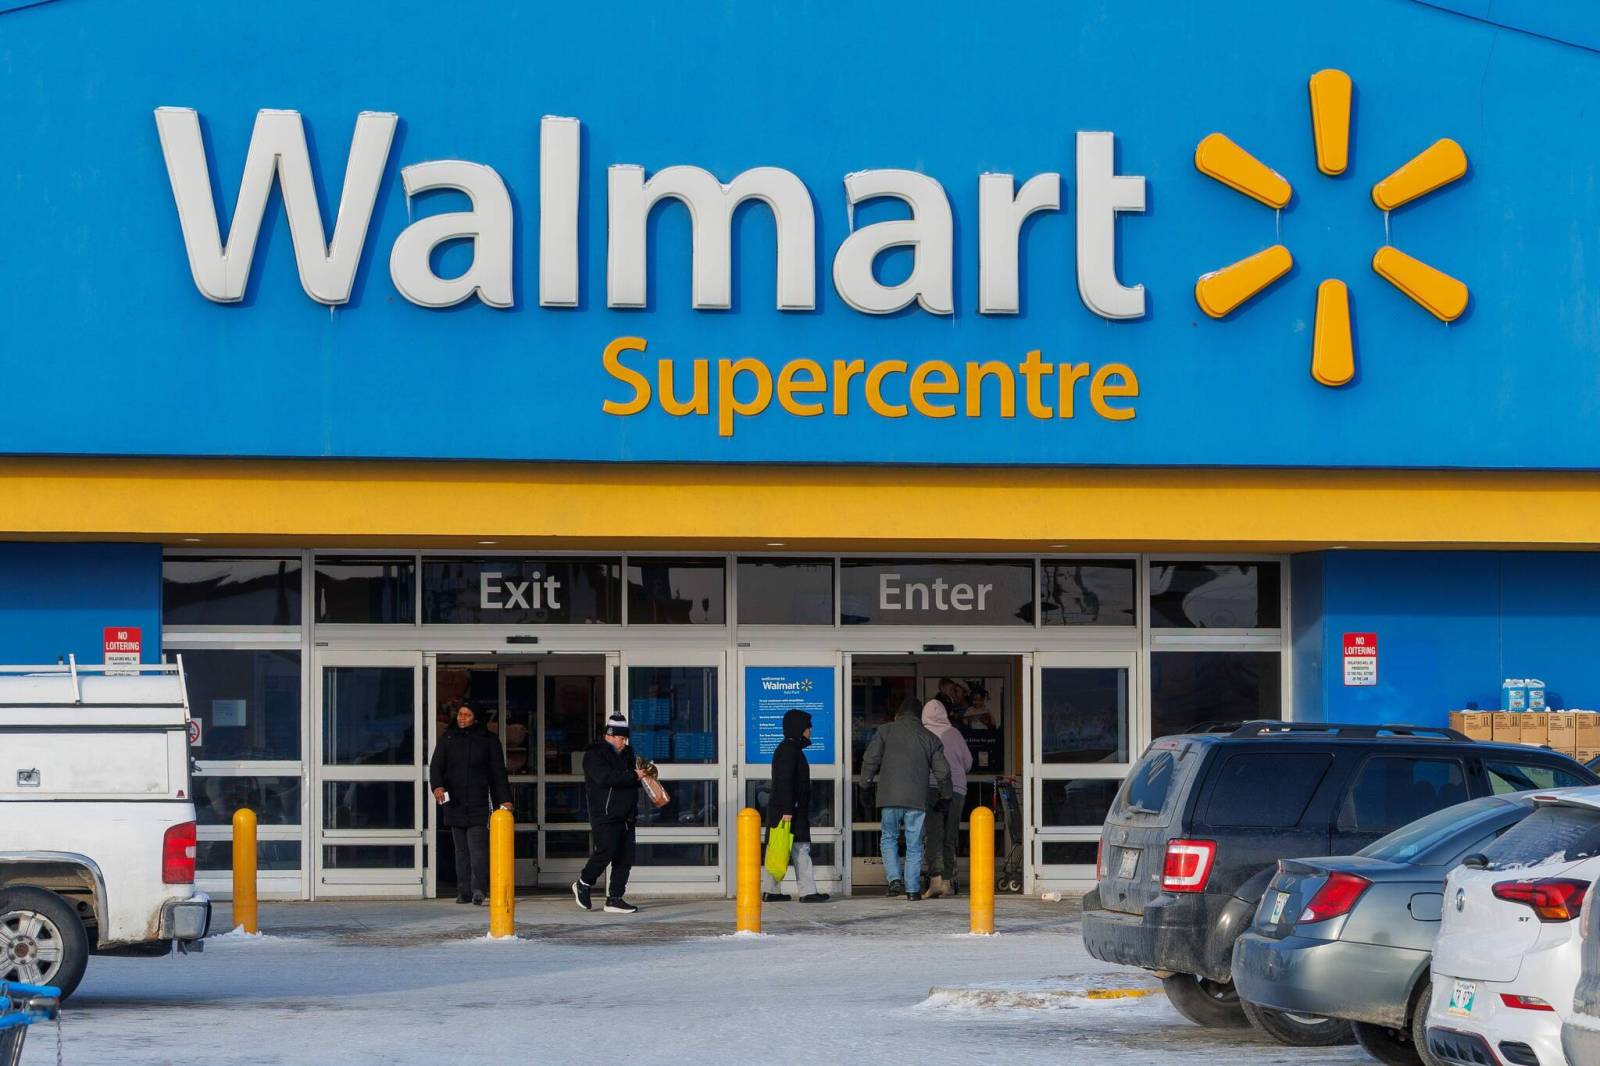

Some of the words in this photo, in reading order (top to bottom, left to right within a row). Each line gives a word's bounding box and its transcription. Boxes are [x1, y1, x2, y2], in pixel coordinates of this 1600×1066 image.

[154, 106, 1148, 321] Walmart
[602, 336, 1139, 438] Supercentre
[479, 572, 562, 611] Exit
[879, 573, 993, 612] Enter
[118, 631, 128, 640] NO
[1356, 636, 1364, 645] NO
[105, 642, 140, 650] LOITERING
[1344, 646, 1376, 655] LOITERING
[762, 681, 800, 690] Walmart
